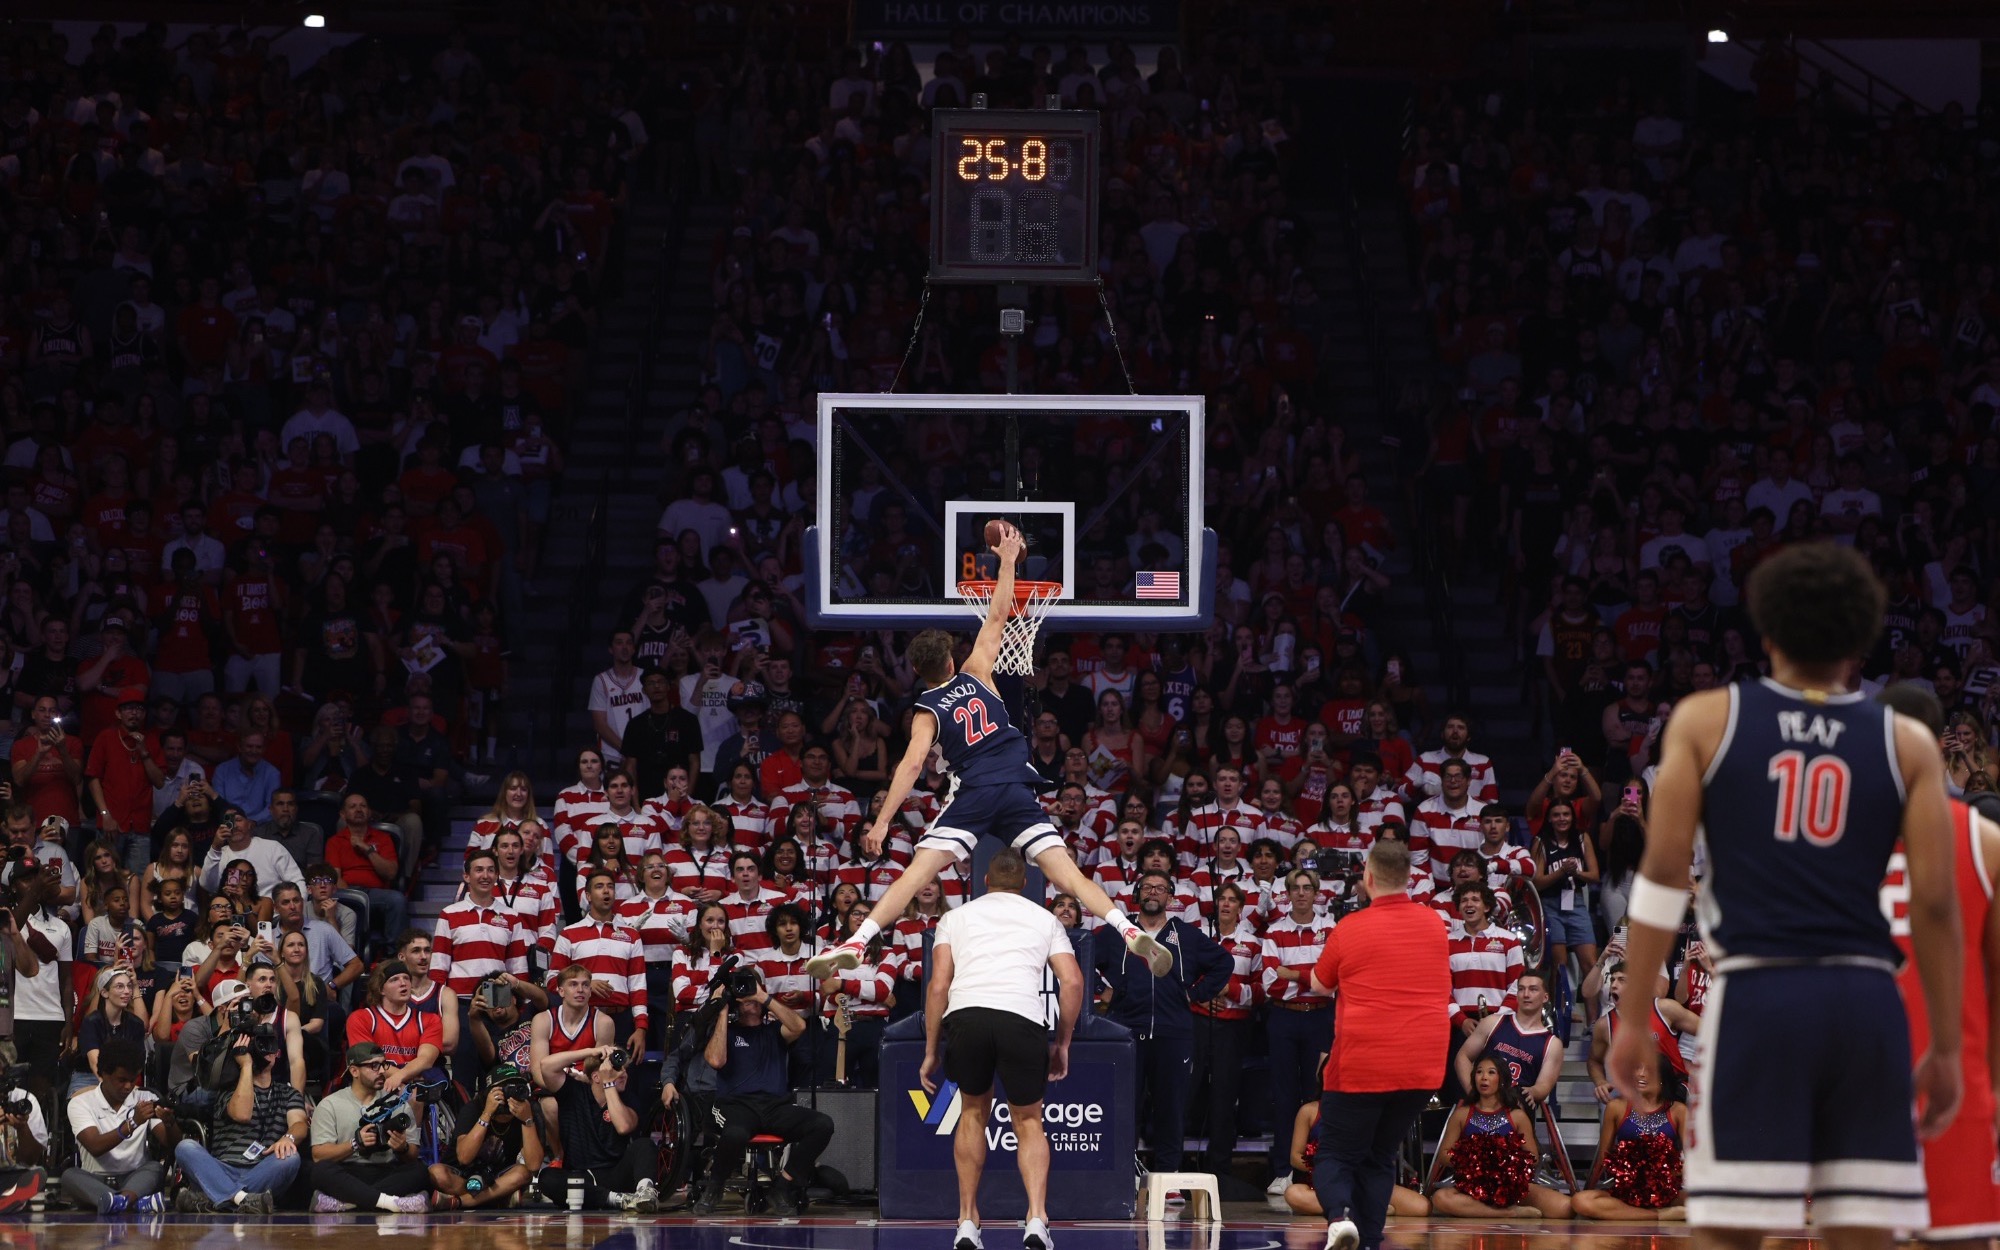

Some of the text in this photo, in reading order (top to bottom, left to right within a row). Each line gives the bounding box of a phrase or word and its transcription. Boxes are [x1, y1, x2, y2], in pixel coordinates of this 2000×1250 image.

[884, 4, 1150, 25] HALL OF CHAMPIONS
[610, 691, 644, 708] ARIZONA
[701, 691, 727, 700] RIZON
[937, 683, 977, 712] ARNOLD
[1168, 697, 1185, 721] 6
[953, 697, 999, 746] 22
[1777, 710, 1847, 749] PEAT
[1767, 749, 1852, 848] 10
[1051, 1132, 1103, 1142] CREDIT
[1054, 1143, 1100, 1152] UNION
